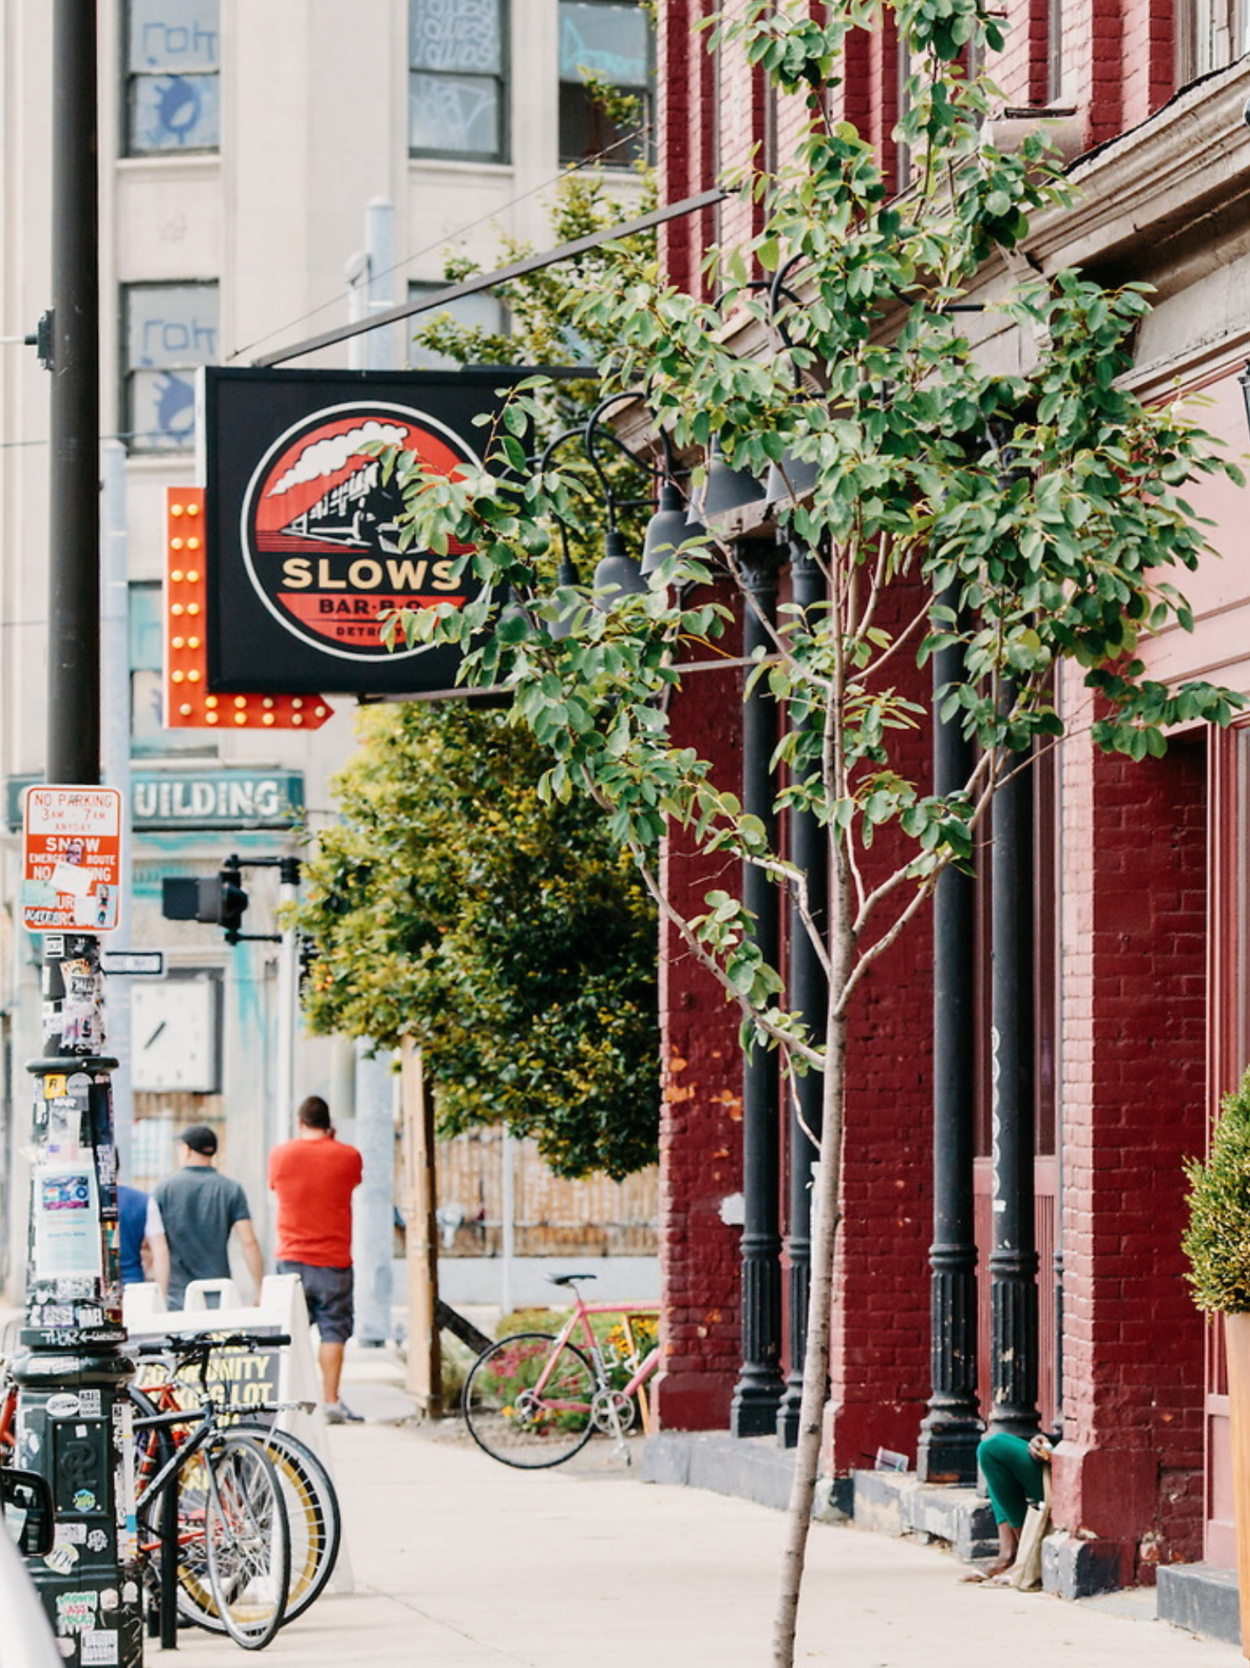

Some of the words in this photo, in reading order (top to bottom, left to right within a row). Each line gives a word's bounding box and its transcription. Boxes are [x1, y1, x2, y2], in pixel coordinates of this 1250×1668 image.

[282, 557, 462, 591] SLOWS
[336, 626, 403, 637] DETRT
[35, 794, 52, 806] NO
[58, 794, 113, 808] PARKING
[136, 781, 278, 816] UILDING
[55, 822, 93, 832] ANYDAY
[86, 855, 116, 866] ROUTE
[33, 865, 52, 881] NO
[140, 1355, 271, 1386] COMUNITY
[230, 1383, 274, 1406] LOT
